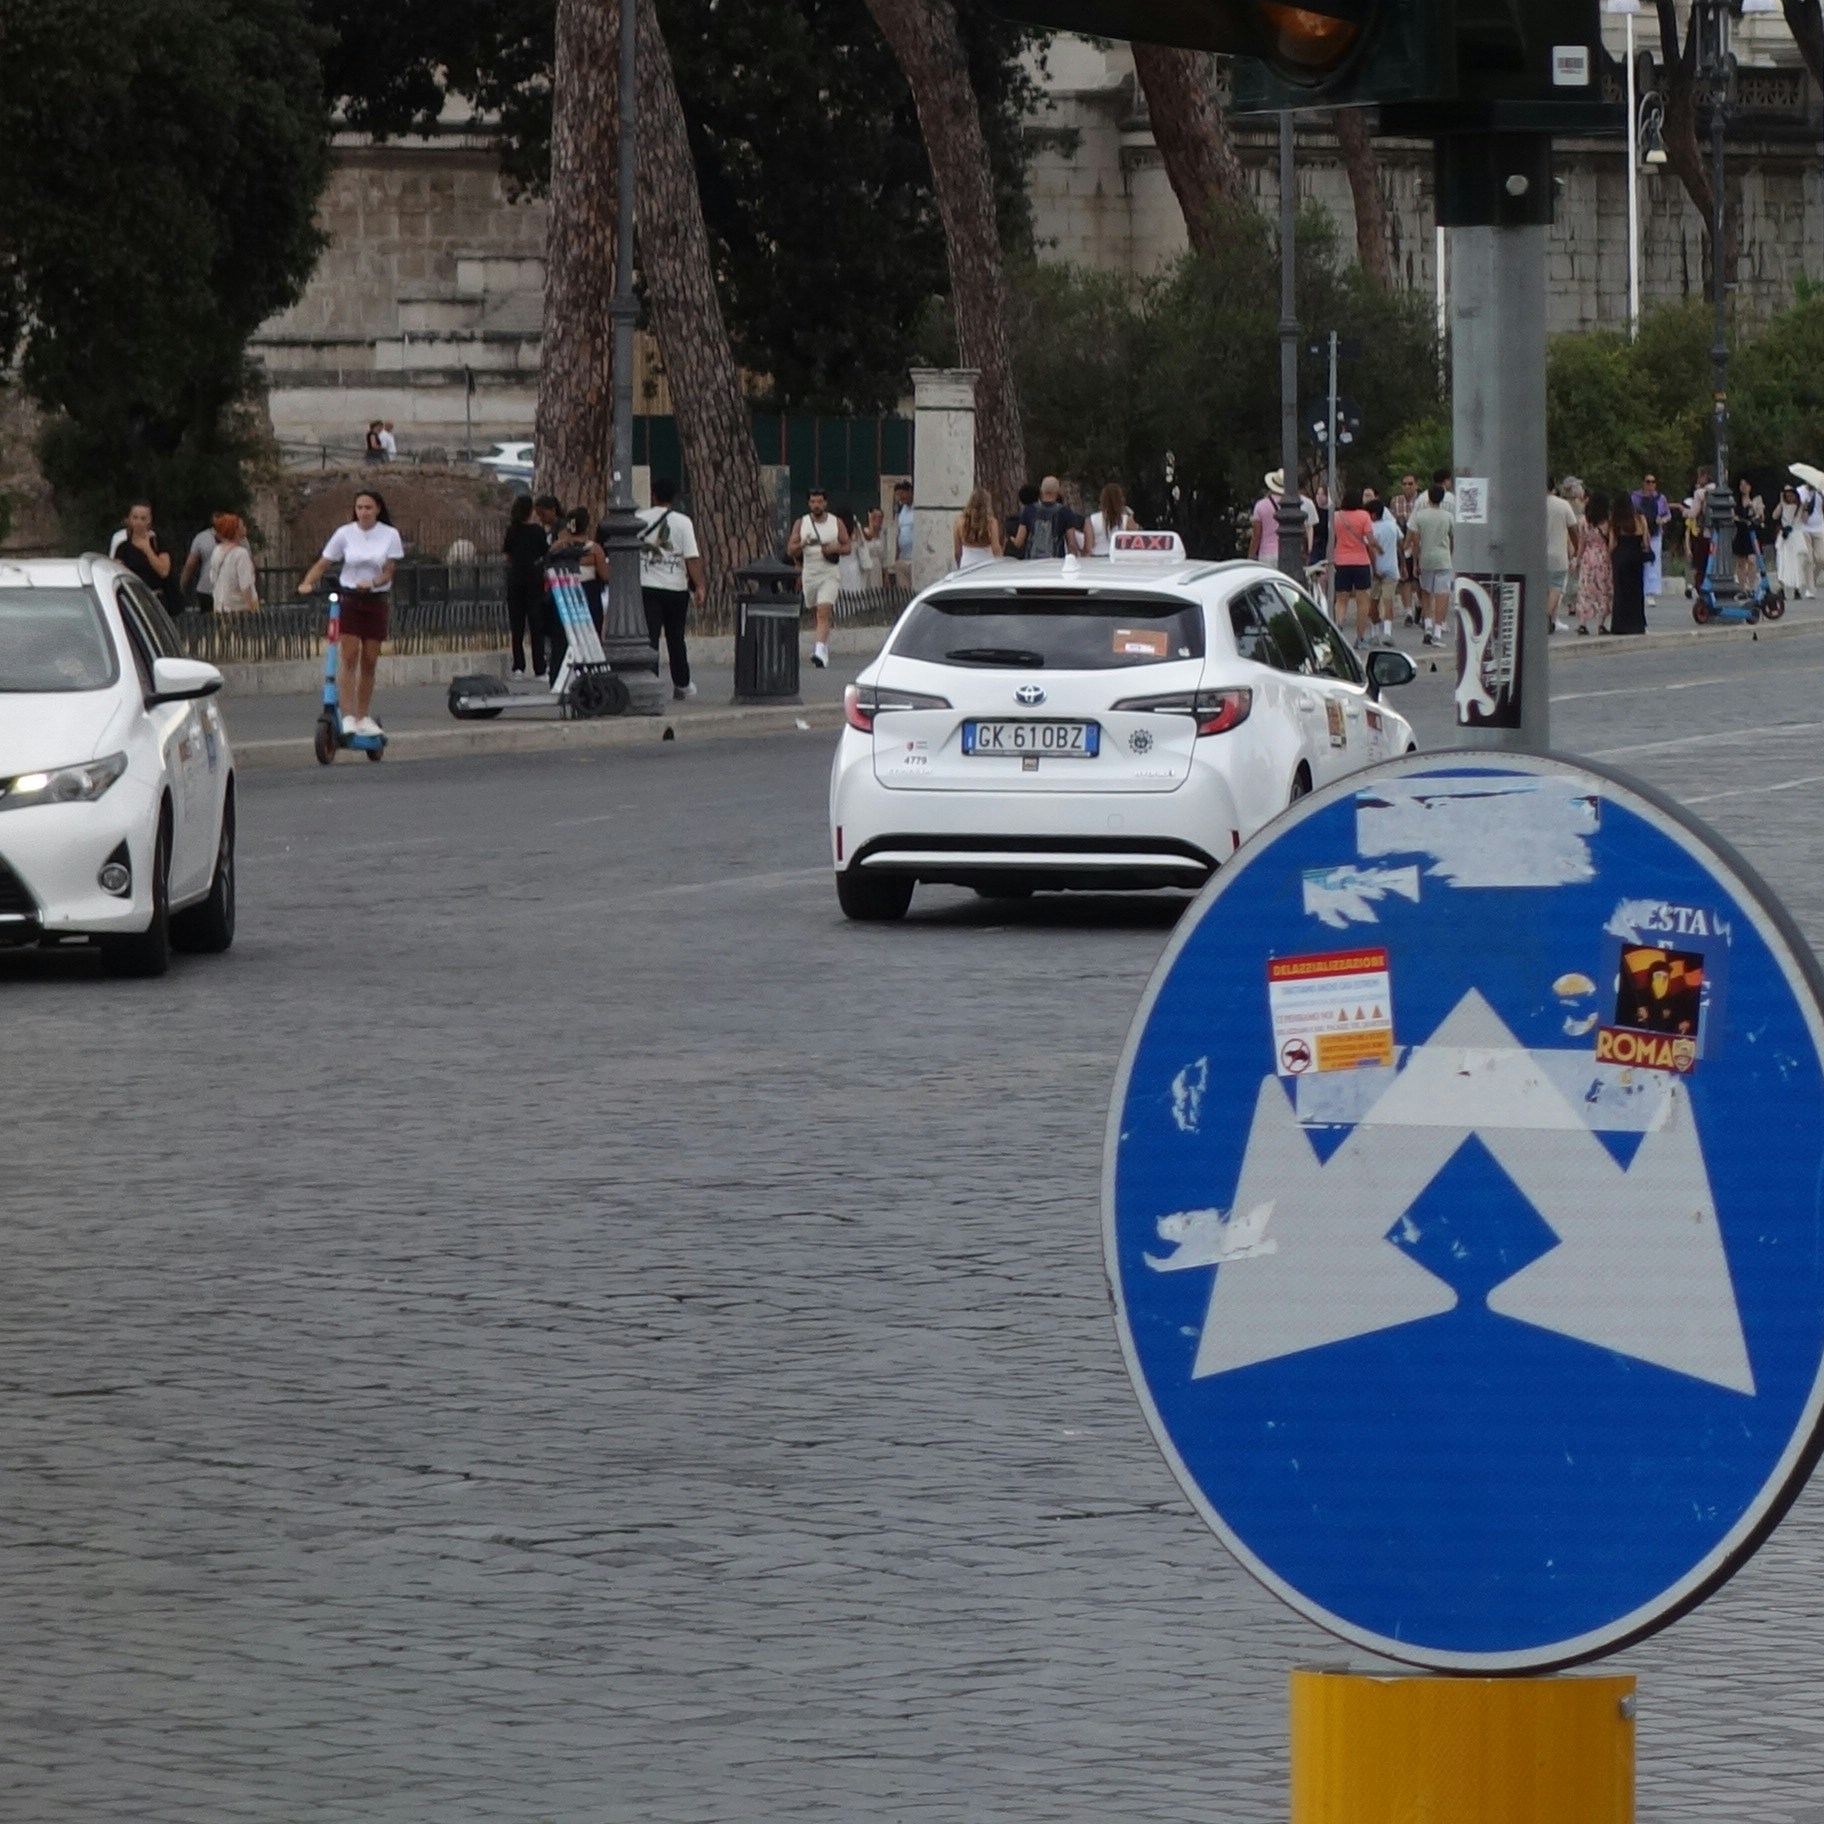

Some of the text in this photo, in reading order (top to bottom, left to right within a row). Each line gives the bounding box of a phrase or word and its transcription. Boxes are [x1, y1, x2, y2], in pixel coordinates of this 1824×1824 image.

[1118, 536, 1172, 550] TAXI
[979, 726, 1083, 750] GK 610BZ
[904, 756, 928, 766] 4779
[1645, 907, 1709, 936] ESTA
[1598, 1030, 1675, 1068] ROMA
